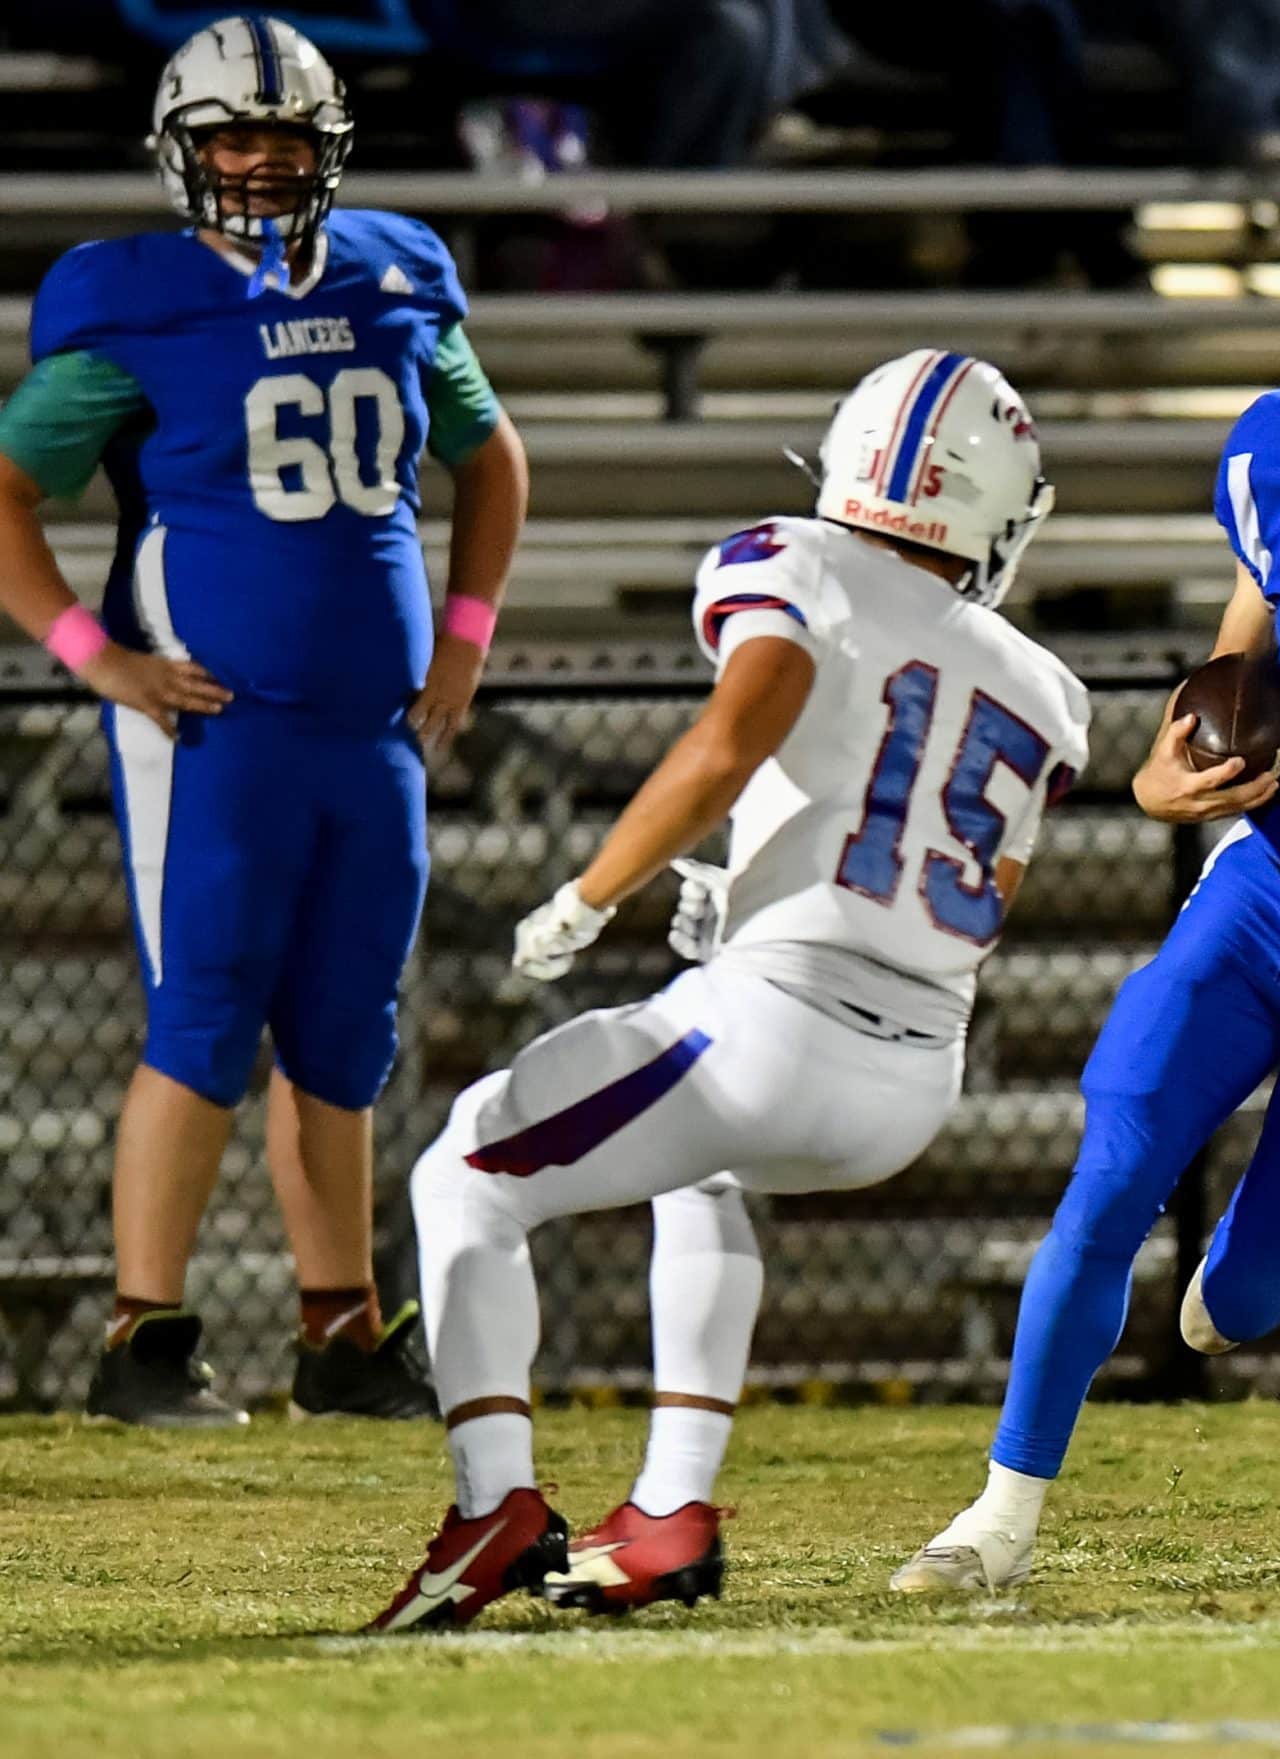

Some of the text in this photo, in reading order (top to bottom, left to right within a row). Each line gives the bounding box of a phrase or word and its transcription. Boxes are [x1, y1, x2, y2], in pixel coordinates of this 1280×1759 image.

[260, 317, 355, 360] LANCERS
[245, 367, 405, 522] 60
[844, 499, 948, 542] Riddell
[834, 659, 1052, 948] 15
